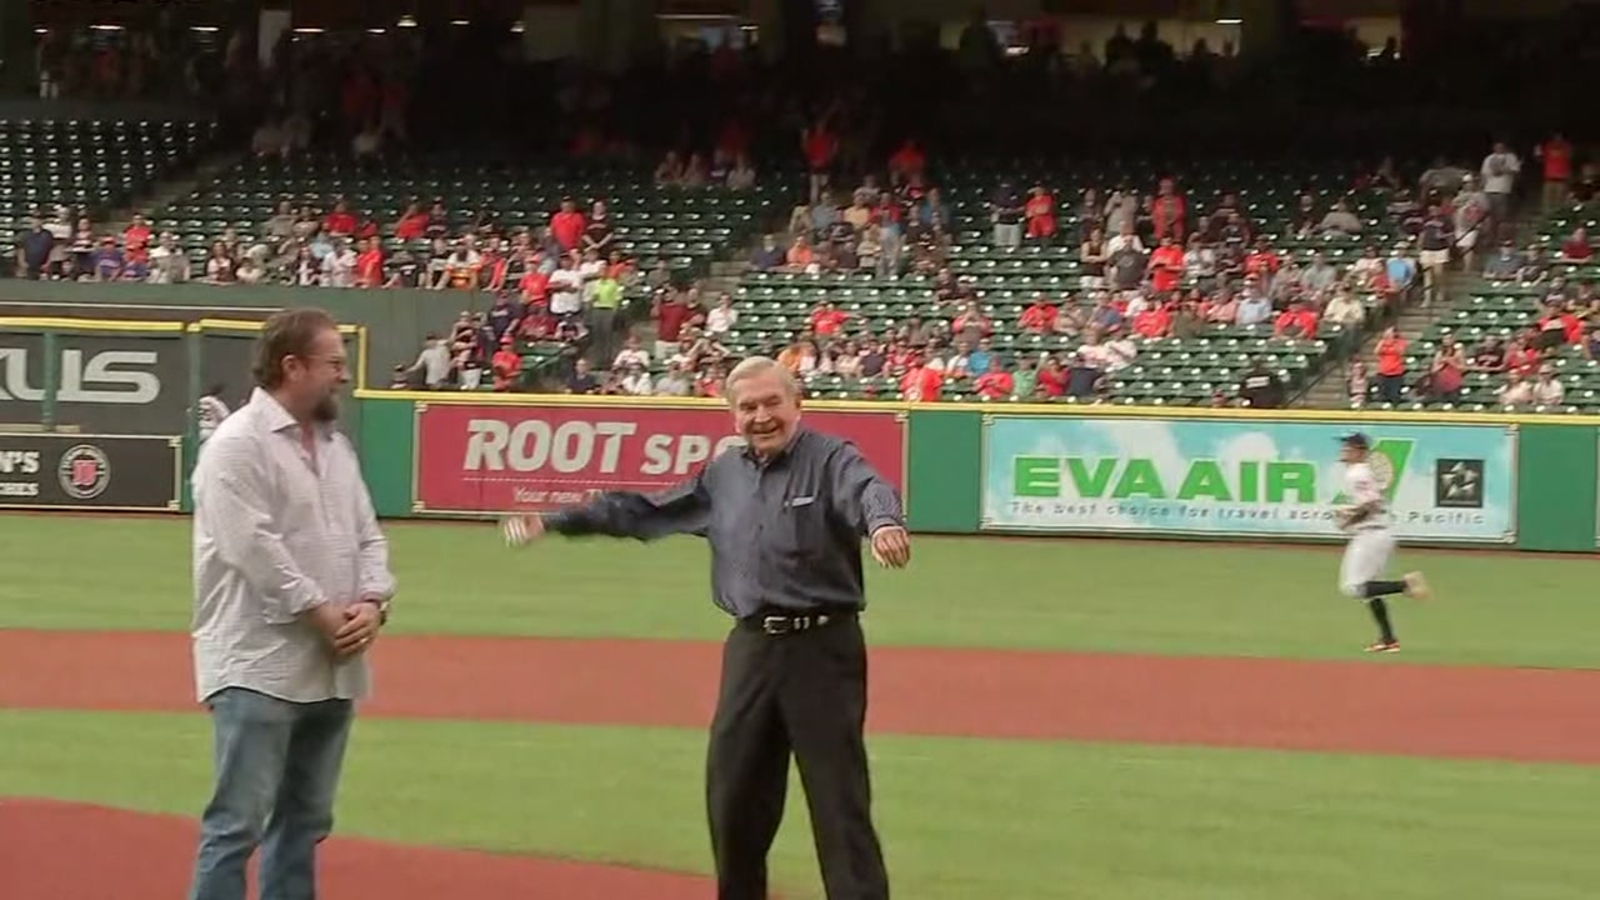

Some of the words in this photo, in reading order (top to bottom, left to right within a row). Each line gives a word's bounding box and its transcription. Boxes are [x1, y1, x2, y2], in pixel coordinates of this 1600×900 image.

[0, 348, 161, 404] US
[464, 419, 637, 473] ROOT
[513, 486, 548, 503] Your
[549, 491, 581, 504] new
[1015, 456, 1166, 499] EVA
[1175, 459, 1315, 503] AIR
[1010, 500, 1043, 515] The
[1053, 500, 1098, 516] best
[1106, 501, 1171, 517] choice
[1179, 504, 1210, 518] for
[1216, 507, 1279, 520] travel
[1288, 508, 1334, 521] acro
[1406, 509, 1484, 525] Pacific
